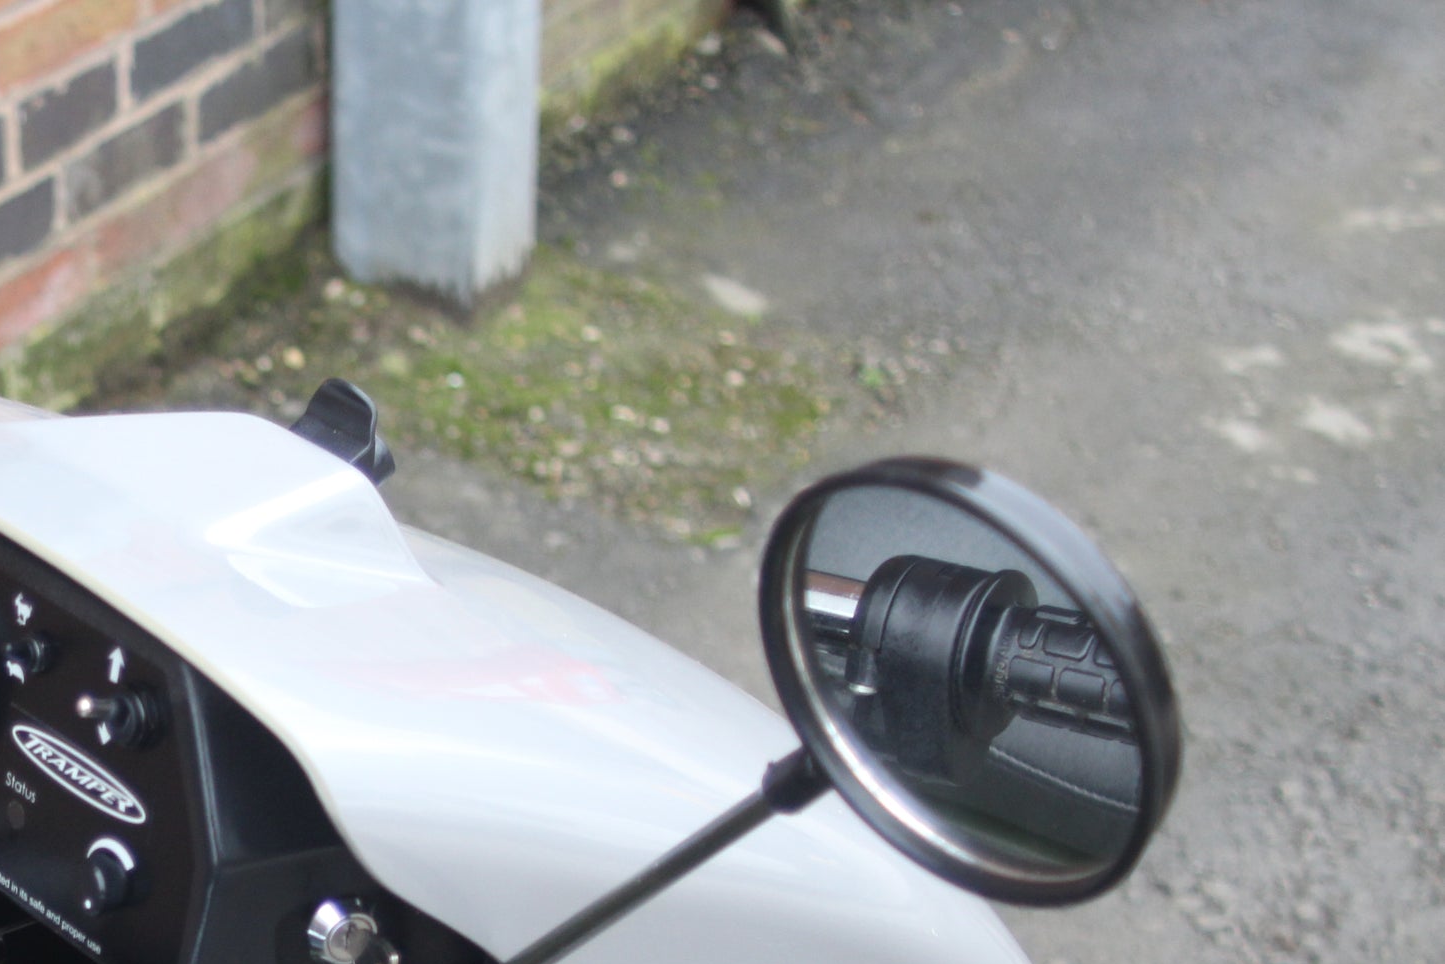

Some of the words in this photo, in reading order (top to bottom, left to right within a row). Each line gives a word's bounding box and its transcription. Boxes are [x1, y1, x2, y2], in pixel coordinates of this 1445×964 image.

[5, 771, 36, 804] Status
[24, 732, 134, 813] TRAMPER
[11, 881, 18, 895] in
[19, 888, 28, 901] its
[29, 897, 45, 914] safe
[46, 909, 61, 925] and
[61, 920, 87, 943] proper
[87, 939, 101, 955] use
